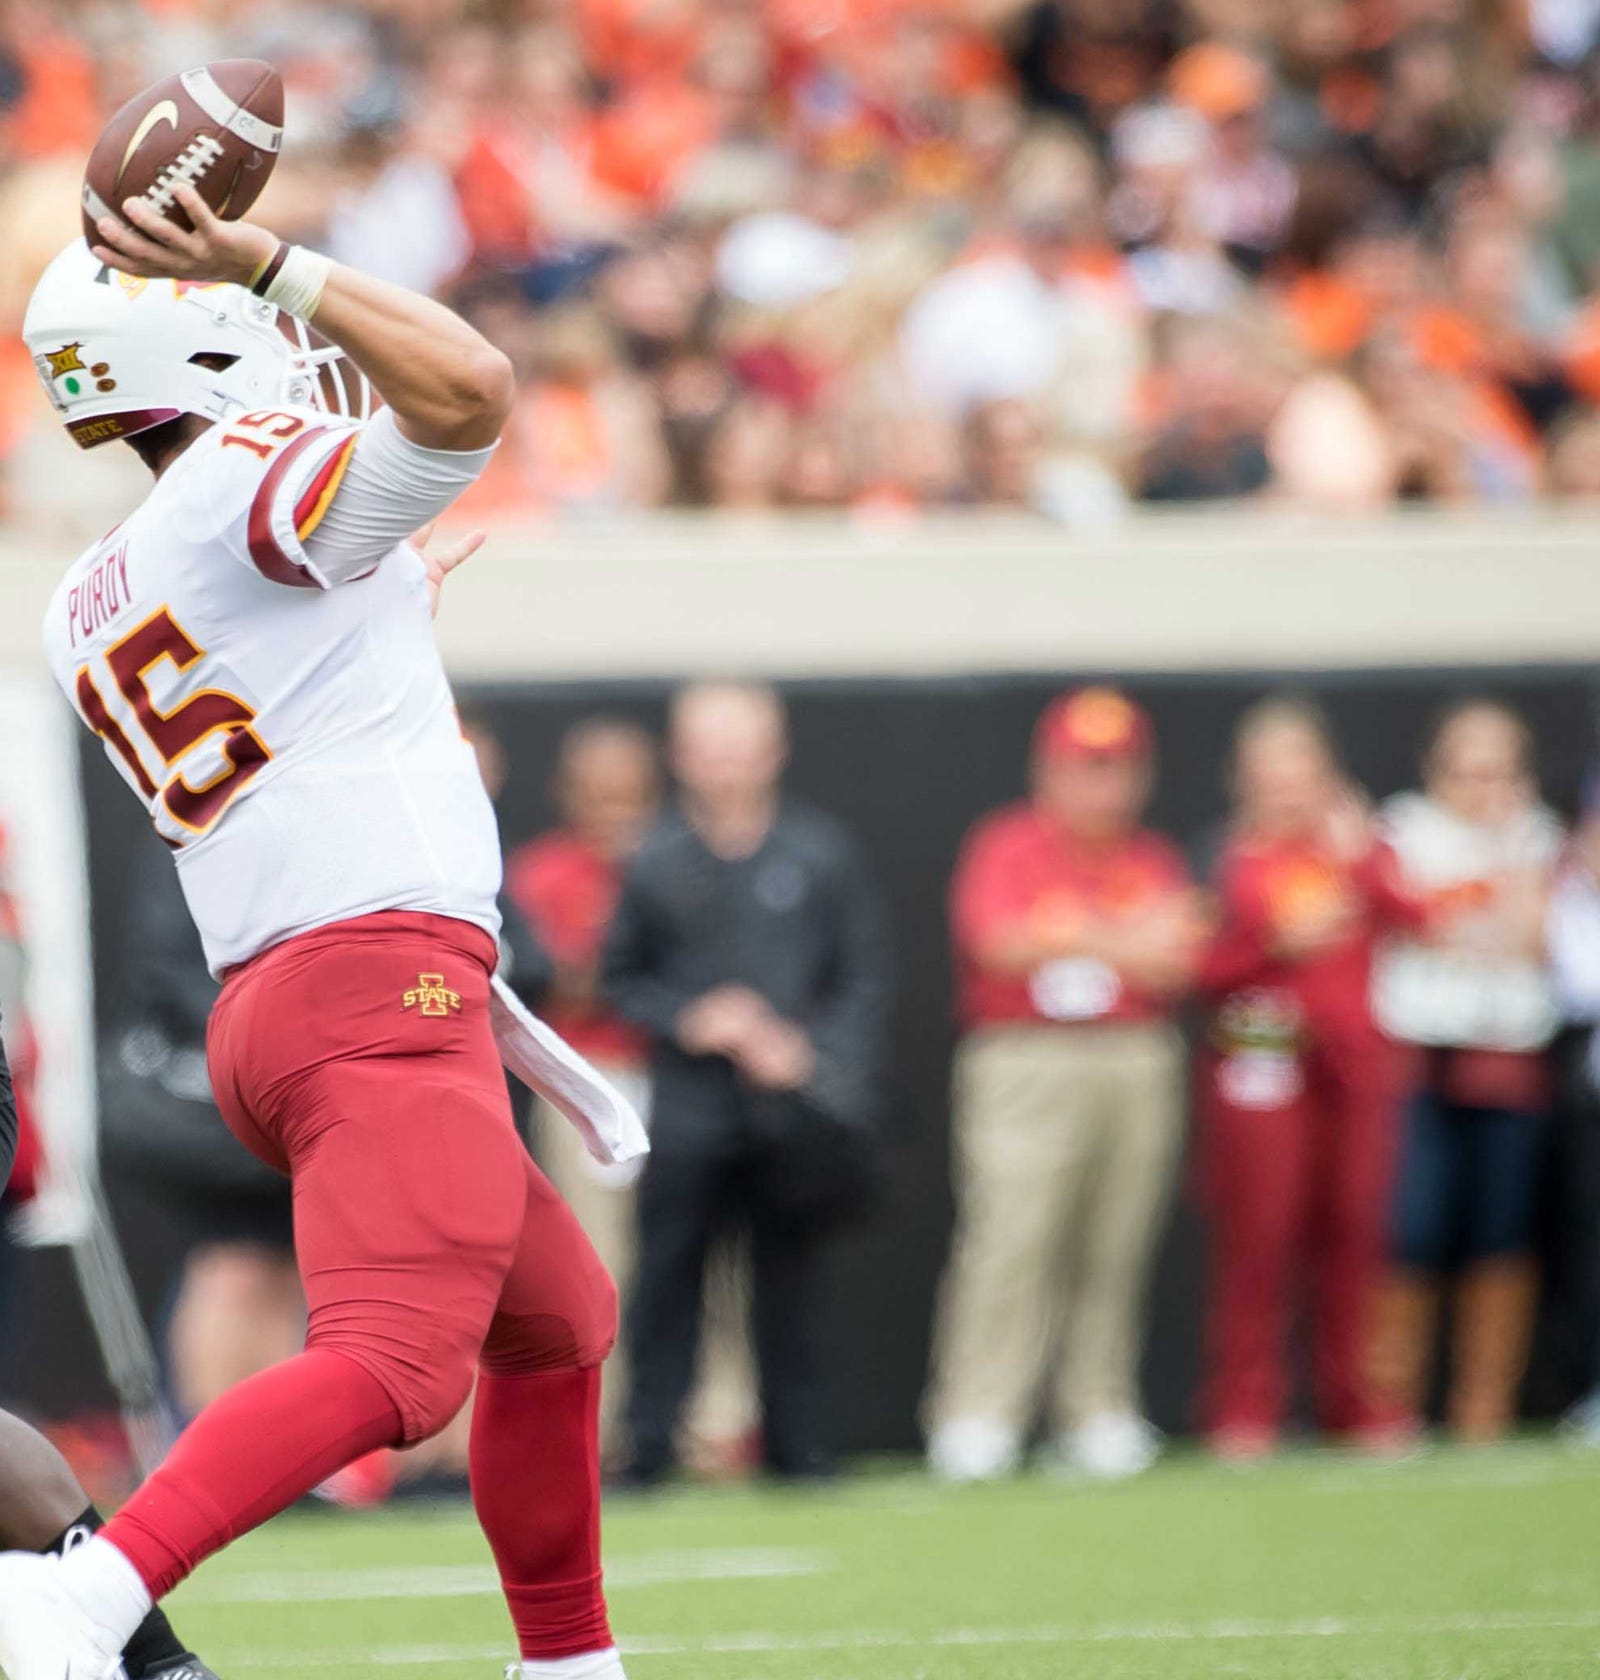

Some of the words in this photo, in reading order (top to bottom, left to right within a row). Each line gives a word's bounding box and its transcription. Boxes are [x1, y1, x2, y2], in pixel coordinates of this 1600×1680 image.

[220, 408, 305, 460] 15
[67, 540, 133, 648] PURDY
[74, 603, 275, 846] 15
[402, 986, 463, 1010] STATE
